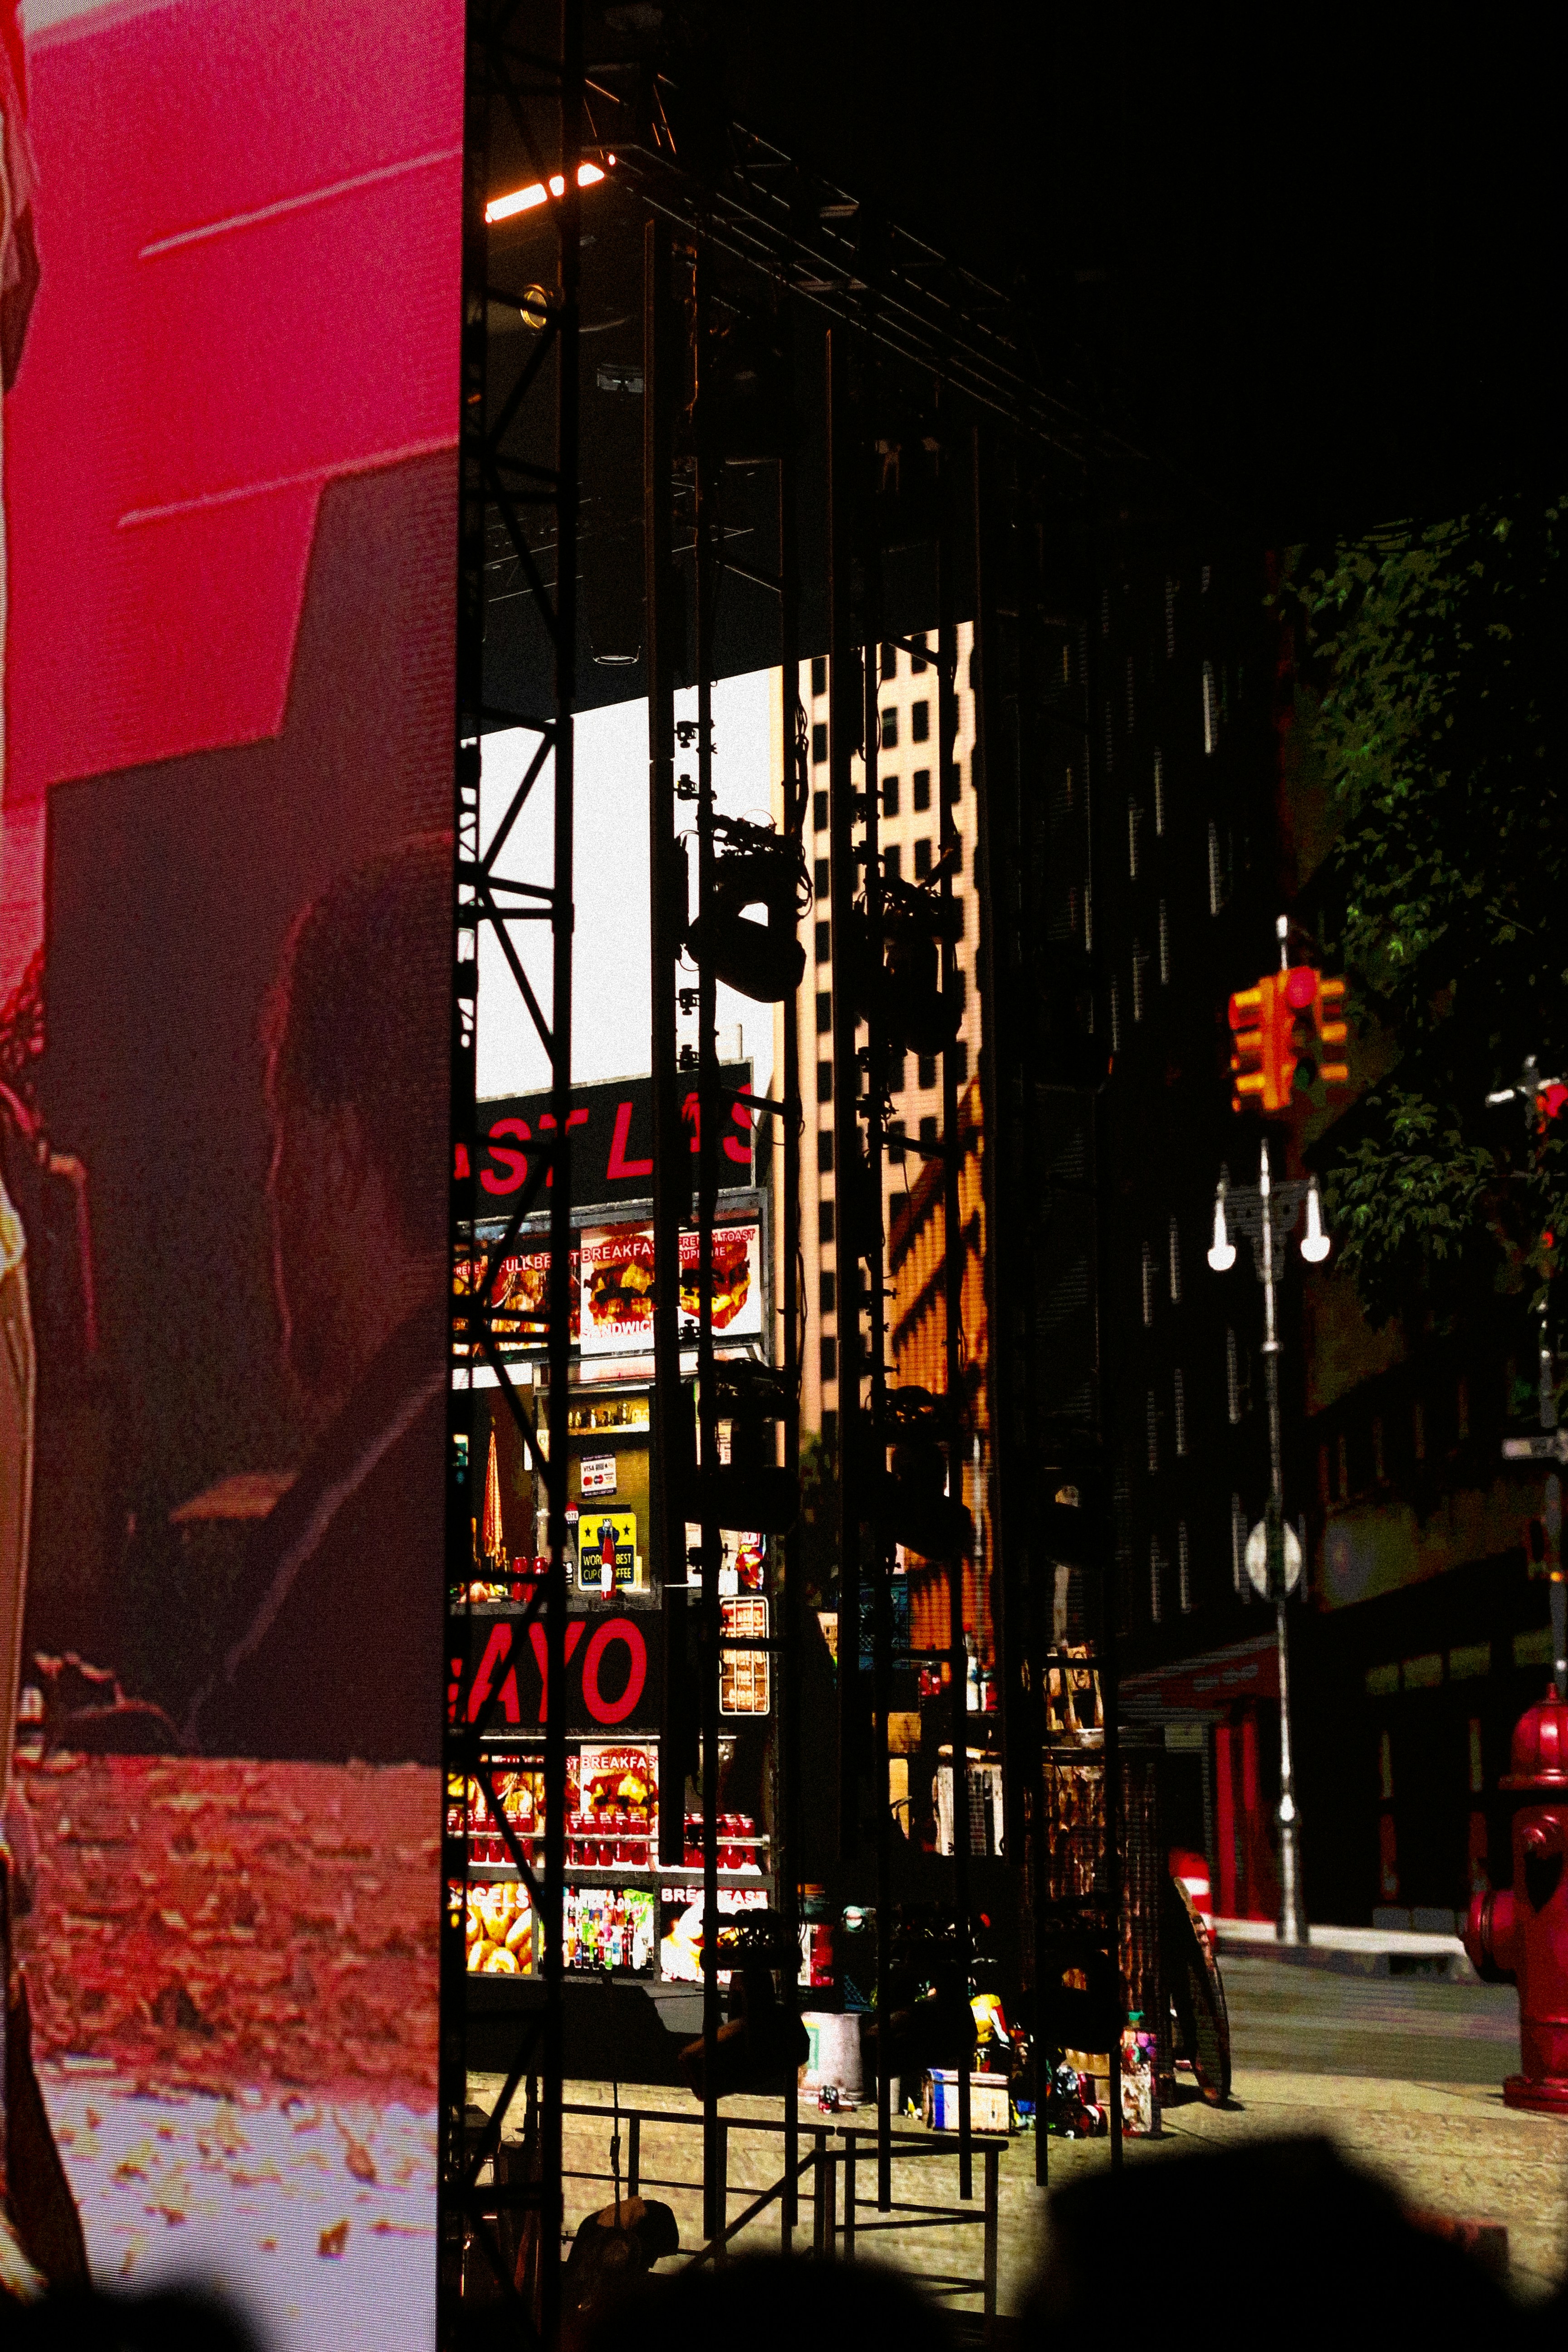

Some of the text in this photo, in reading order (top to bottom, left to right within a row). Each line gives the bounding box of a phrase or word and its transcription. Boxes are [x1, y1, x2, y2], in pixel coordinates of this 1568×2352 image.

[721, 1229, 755, 1242] TOAST
[582, 1242, 654, 1262] BREAKFA
[582, 1320, 653, 1338] SANDWIC
[616, 1553, 631, 1564] BEST
[584, 1569, 597, 1580] CUP
[581, 1756, 657, 1769] BREAKFAS
